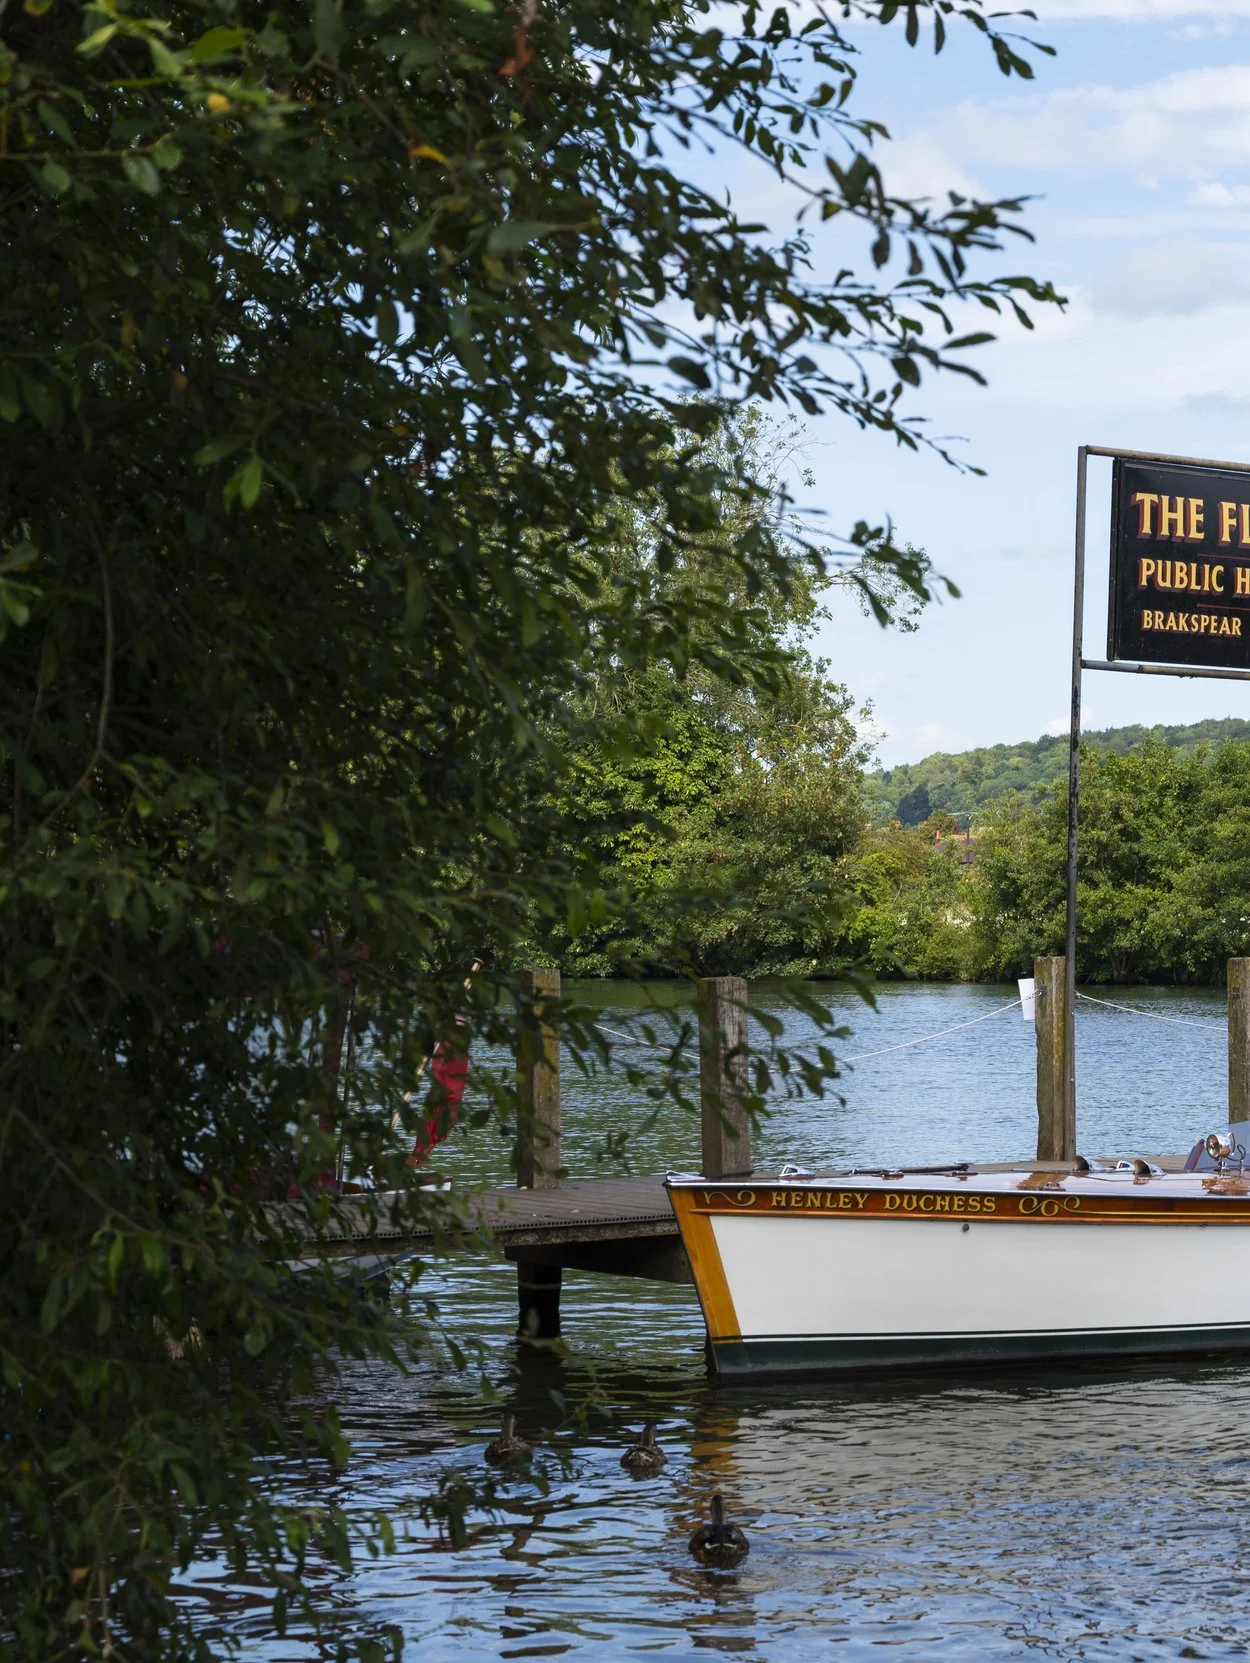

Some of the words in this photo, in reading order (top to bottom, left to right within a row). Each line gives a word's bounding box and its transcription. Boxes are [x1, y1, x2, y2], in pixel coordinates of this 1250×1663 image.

[1131, 492, 1205, 542] THE
[1137, 558, 1224, 594] PUBLIC
[1141, 609, 1242, 637] BRAKSPEAR
[771, 1191, 869, 1208] HENLEY
[884, 1194, 996, 1212] DUCHESS
